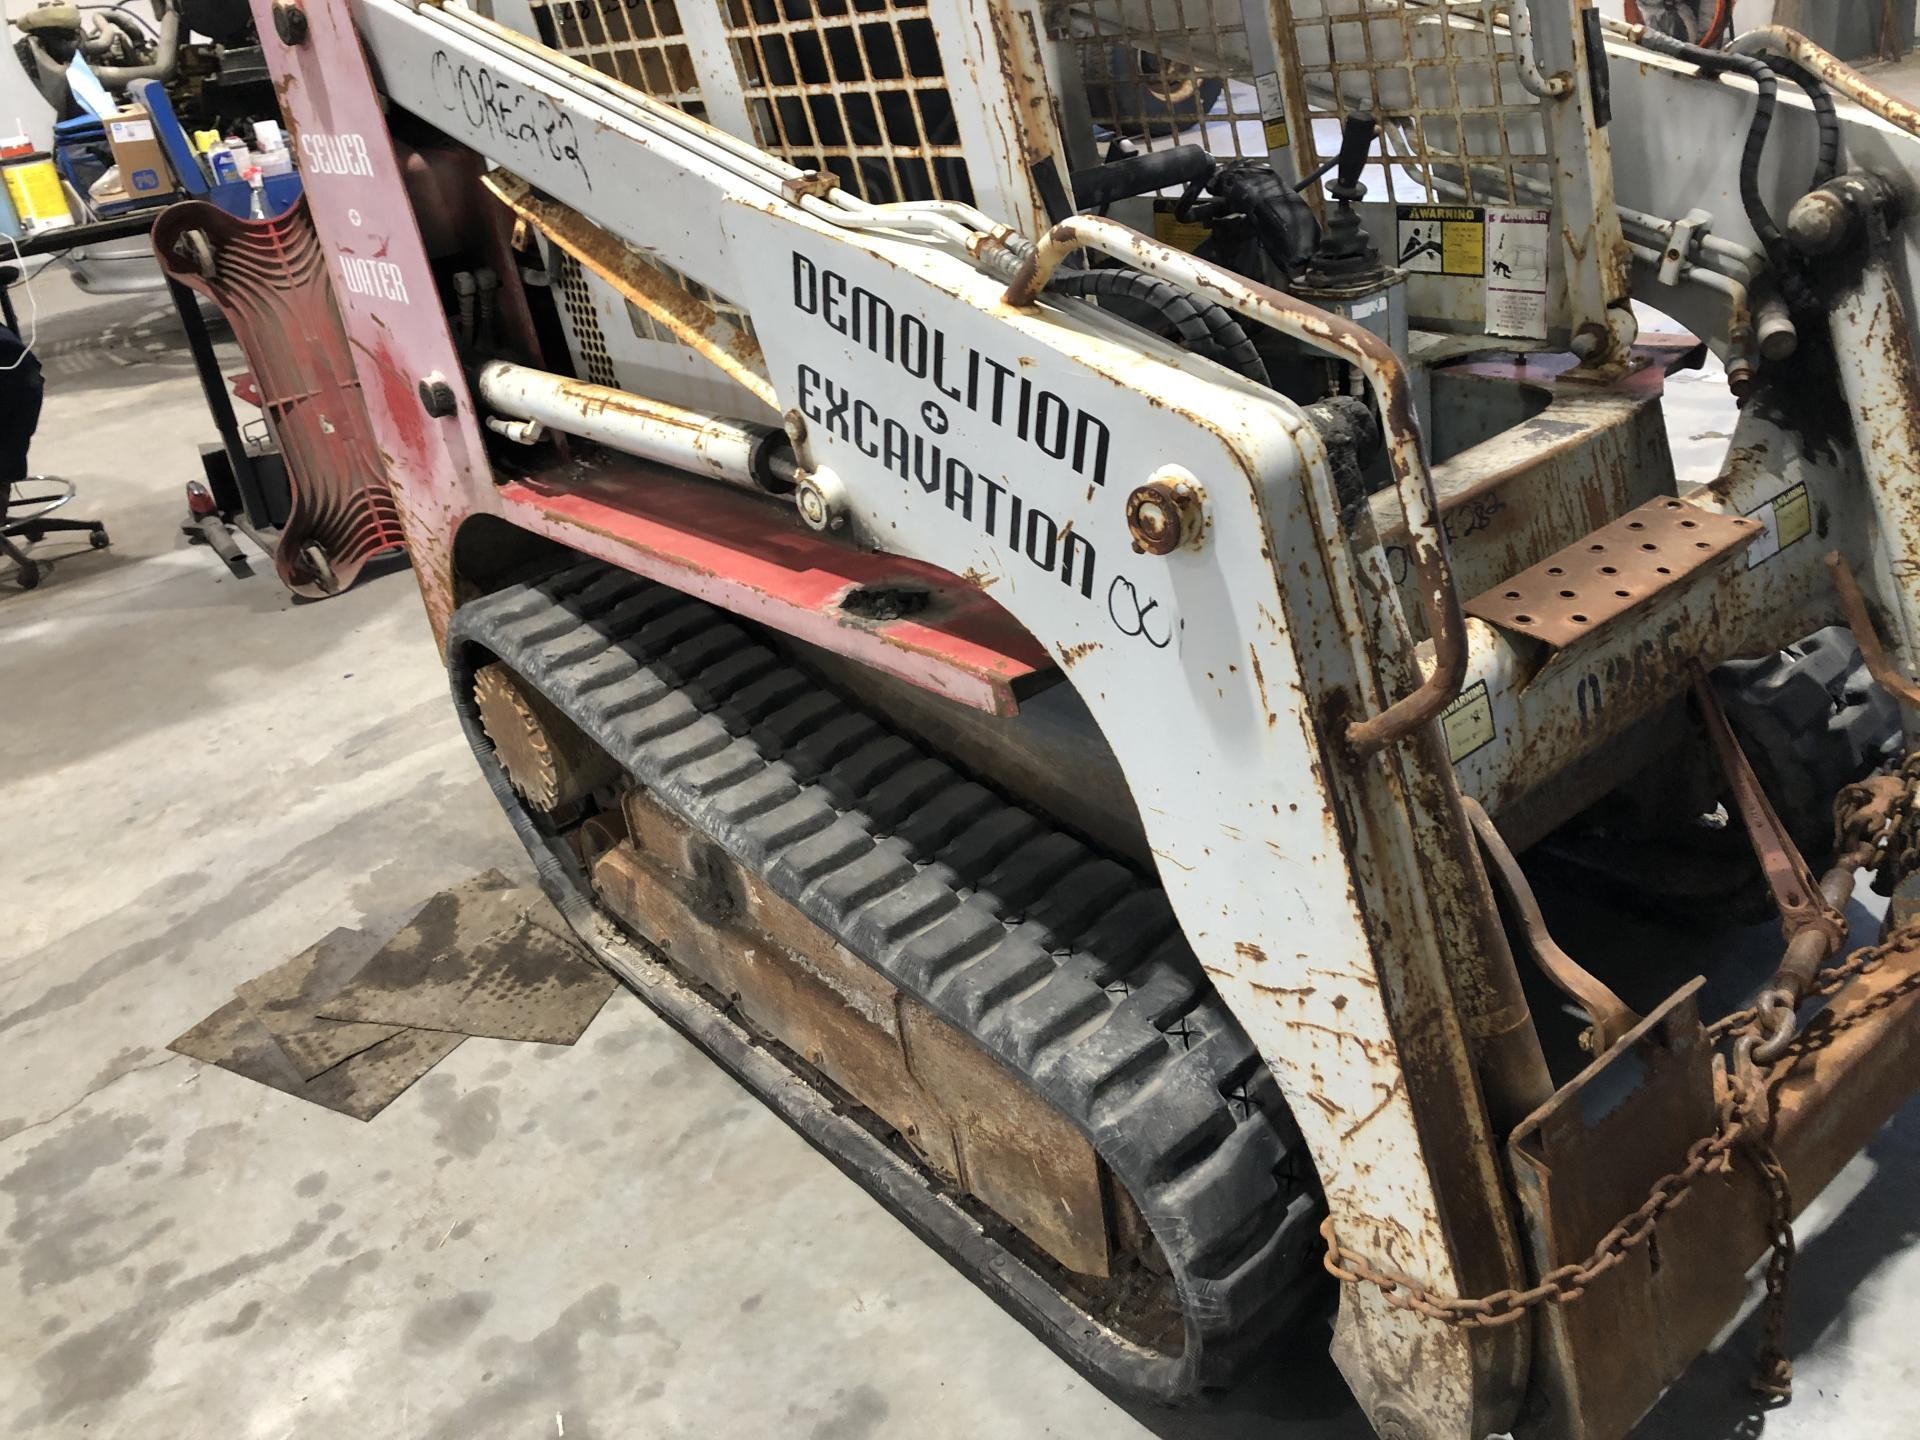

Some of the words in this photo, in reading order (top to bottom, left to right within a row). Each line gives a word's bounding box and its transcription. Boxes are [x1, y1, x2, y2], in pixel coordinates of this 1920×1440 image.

[301, 133, 375, 178] SEWER
[1420, 207, 1475, 221] WARNING
[339, 255, 410, 305] WATER
[792, 250, 1111, 488] DEMOLITION
[797, 363, 1097, 600] EXCAVATION
[1446, 683, 1488, 714] WARNING
